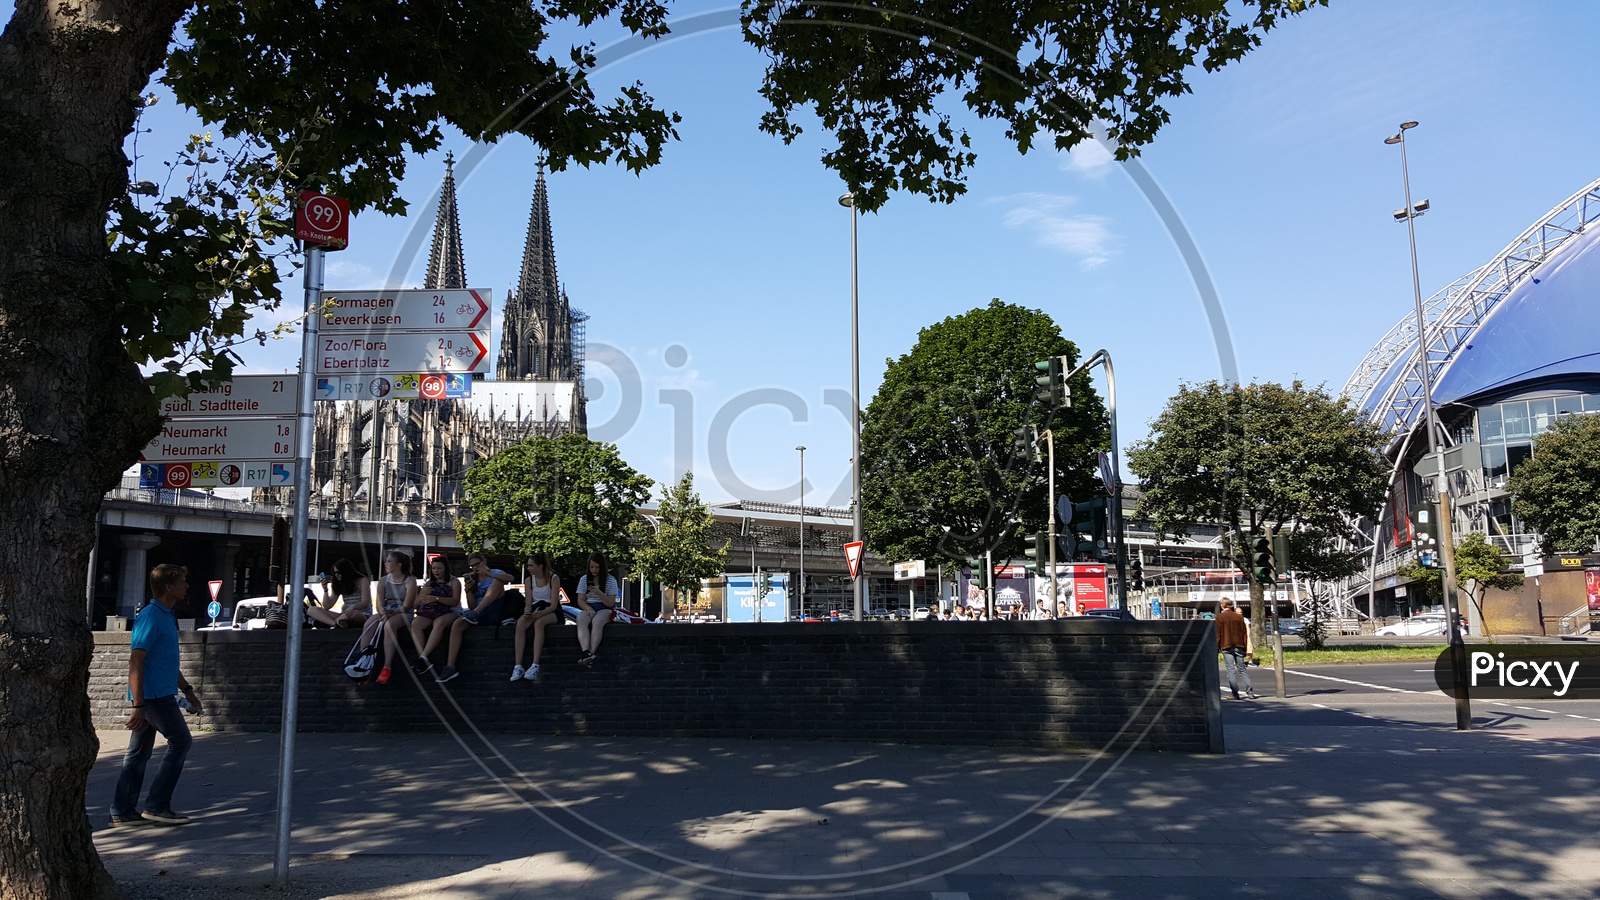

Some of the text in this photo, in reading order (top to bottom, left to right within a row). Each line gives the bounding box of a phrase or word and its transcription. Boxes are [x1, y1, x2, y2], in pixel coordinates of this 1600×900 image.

[313, 204, 334, 223] 99
[432, 295, 446, 307] 24
[434, 312, 445, 324] 16
[324, 339, 387, 351] Zoo/Flora
[324, 356, 390, 369] Ebertplatz
[272, 380, 284, 393] 21
[425, 381, 440, 391] 98
[165, 399, 259, 412] südl. Stadtteile
[163, 425, 228, 438] Neumarkt
[162, 443, 227, 456] Heumarkt
[171, 471, 185, 480] 99
